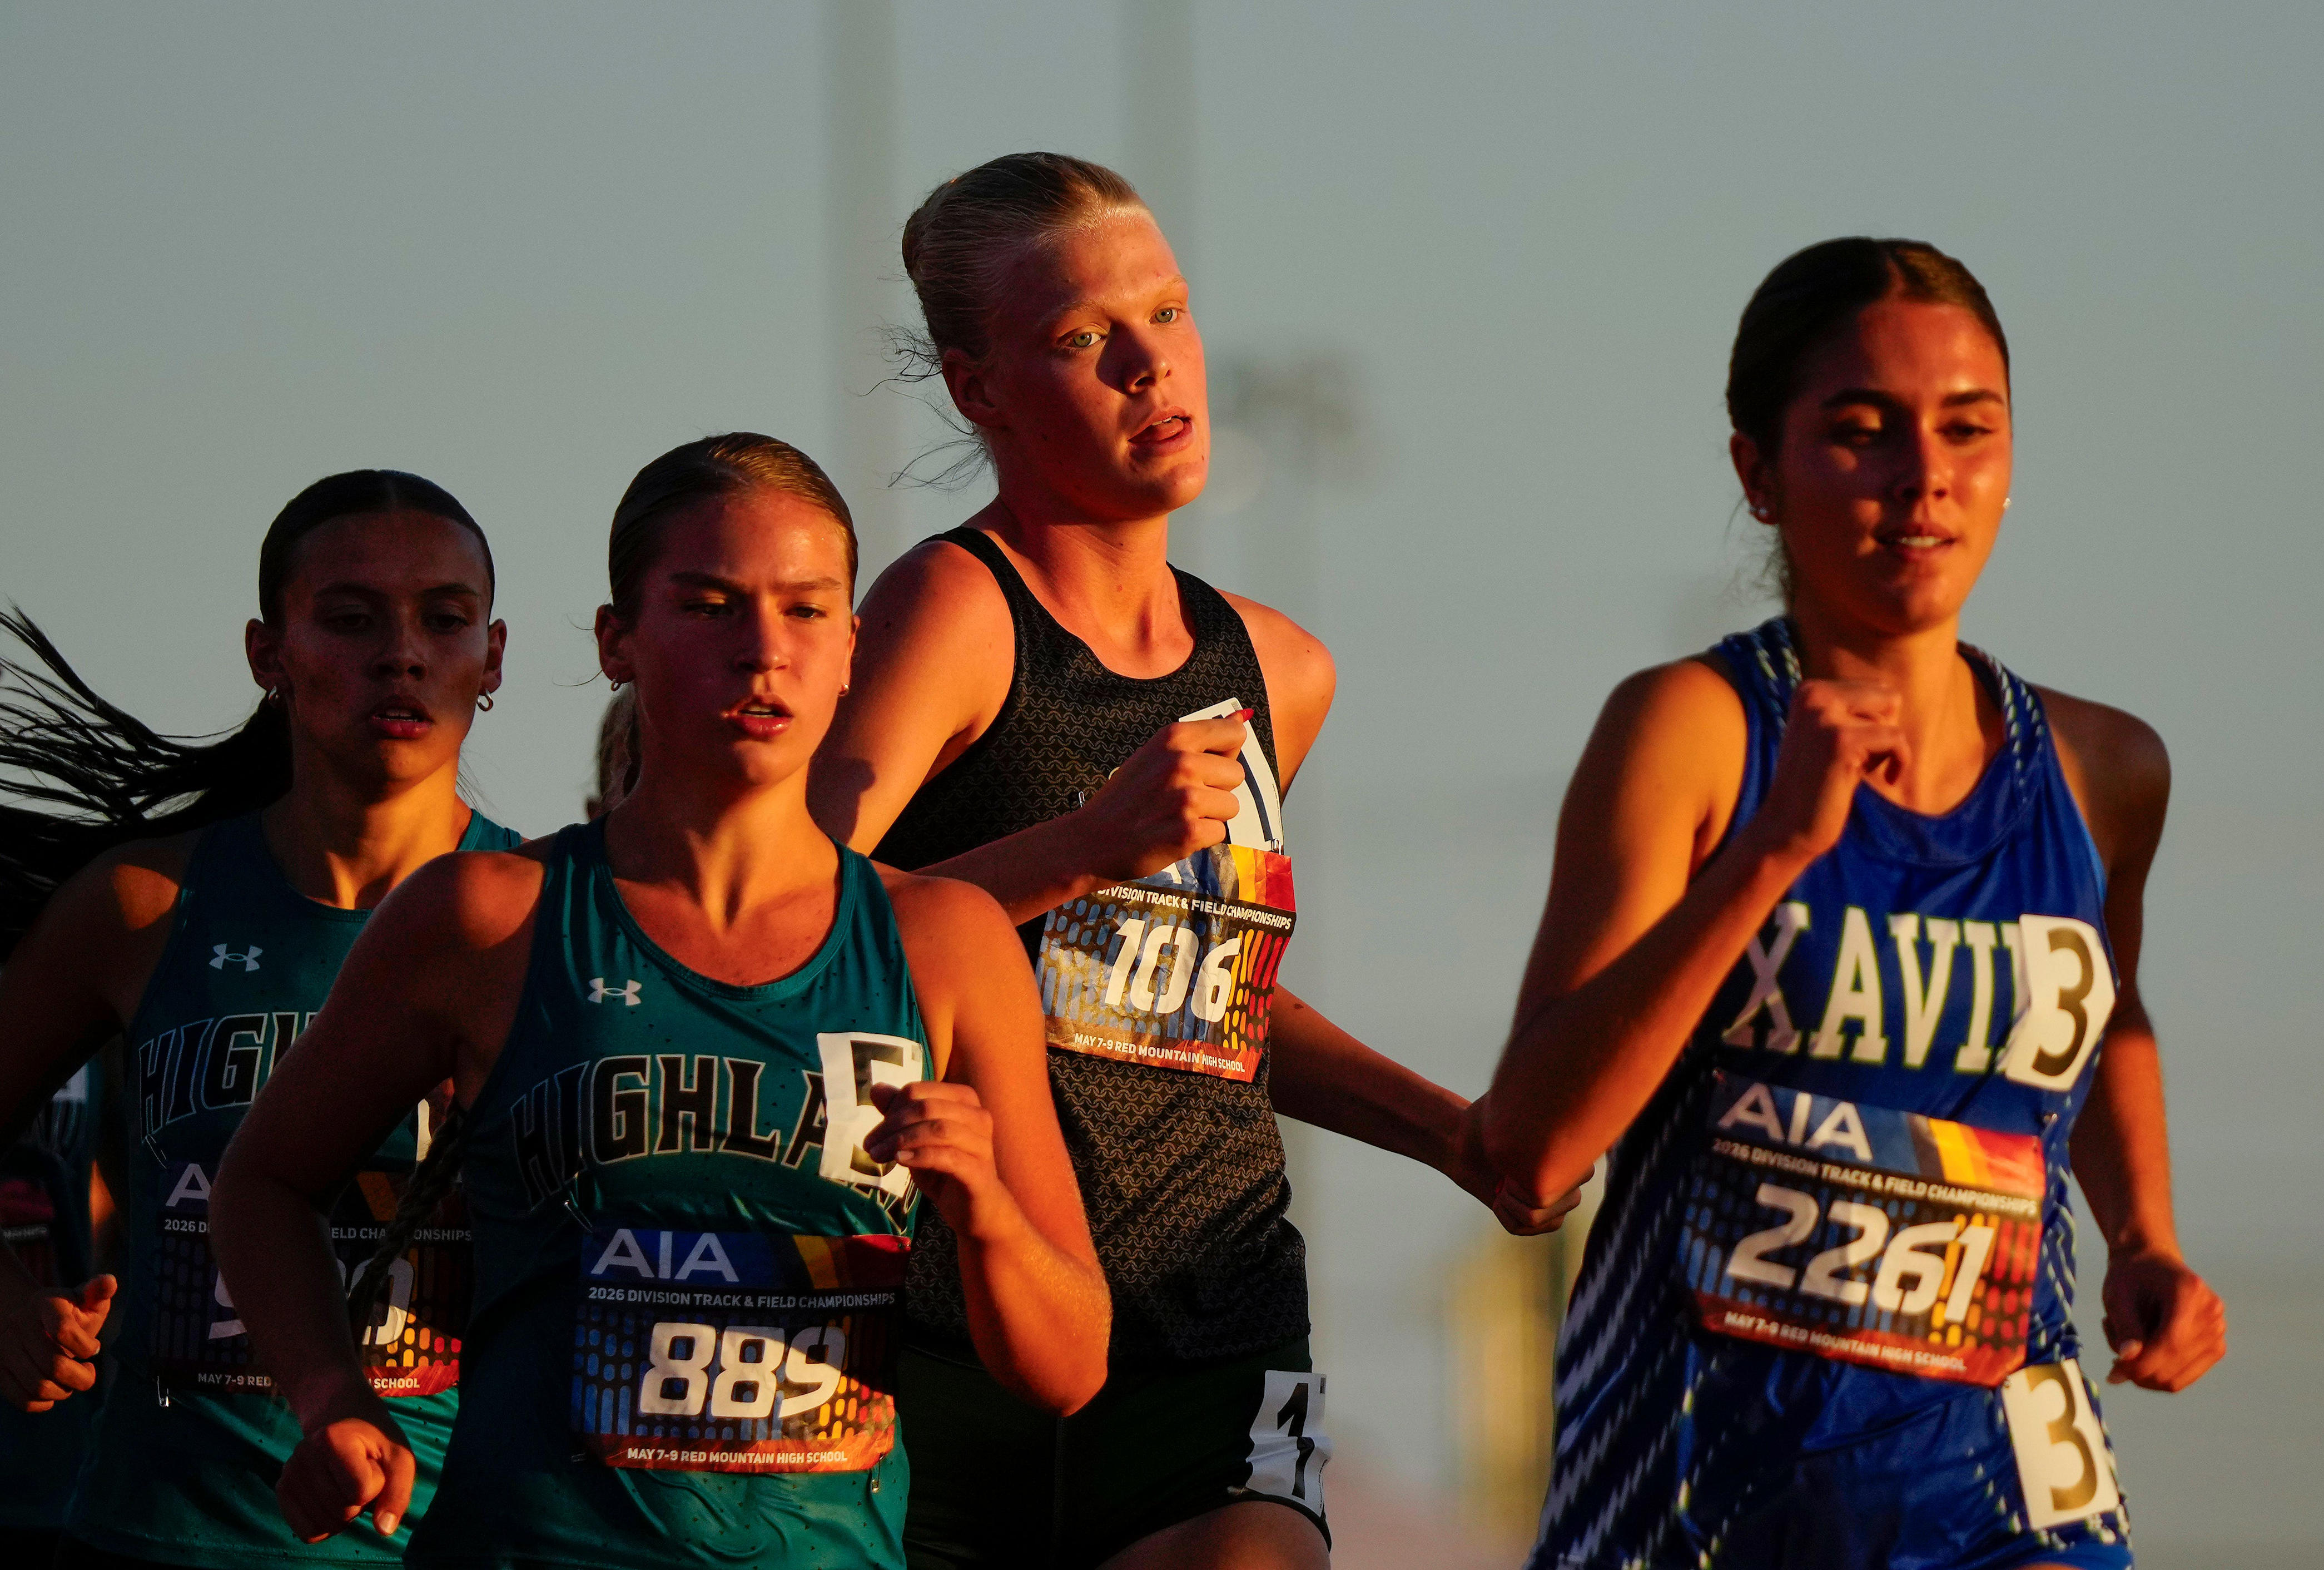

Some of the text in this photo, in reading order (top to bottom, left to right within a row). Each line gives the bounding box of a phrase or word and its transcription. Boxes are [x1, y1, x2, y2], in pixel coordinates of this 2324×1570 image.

[1146, 891, 1180, 908] TRACK
[1181, 897, 1189, 910] &
[1191, 899, 1228, 915] FIELD
[1226, 905, 1292, 930] CHAMPIONSHIPS
[1105, 918, 1242, 1023] 106
[2032, 927, 2094, 1077] 3
[1074, 1032, 1246, 1073] MAY 7-9 RED MOUNTAIN HIGH SCHOOL
[1716, 1082, 1874, 1162] AIA
[1712, 1137, 2038, 1217] 2026 DIVISION TRACK & FIELD CHAMPIONSHIPS
[164, 1219, 196, 1232] 2026
[590, 1228, 740, 1282] AIA
[1726, 1182, 1999, 1323] 2261
[588, 1286, 896, 1308] 2026 DIVISION TRACK & FIELD CHAMPIONSHIPS
[639, 1322, 846, 1419] 889
[1724, 1310, 1968, 1373] MAY 7-9 RED MOUNTAIN HIGH SCHOOL
[197, 1373, 272, 1388] MAY 7-9 RED
[373, 1378, 420, 1389] SCHOOL
[627, 1447, 848, 1464] MAY 7-9 RED MOUNTAIN HIGH SCHOOL
[1277, 1383, 1315, 1500] 1
[2025, 1366, 2099, 1512] 3
